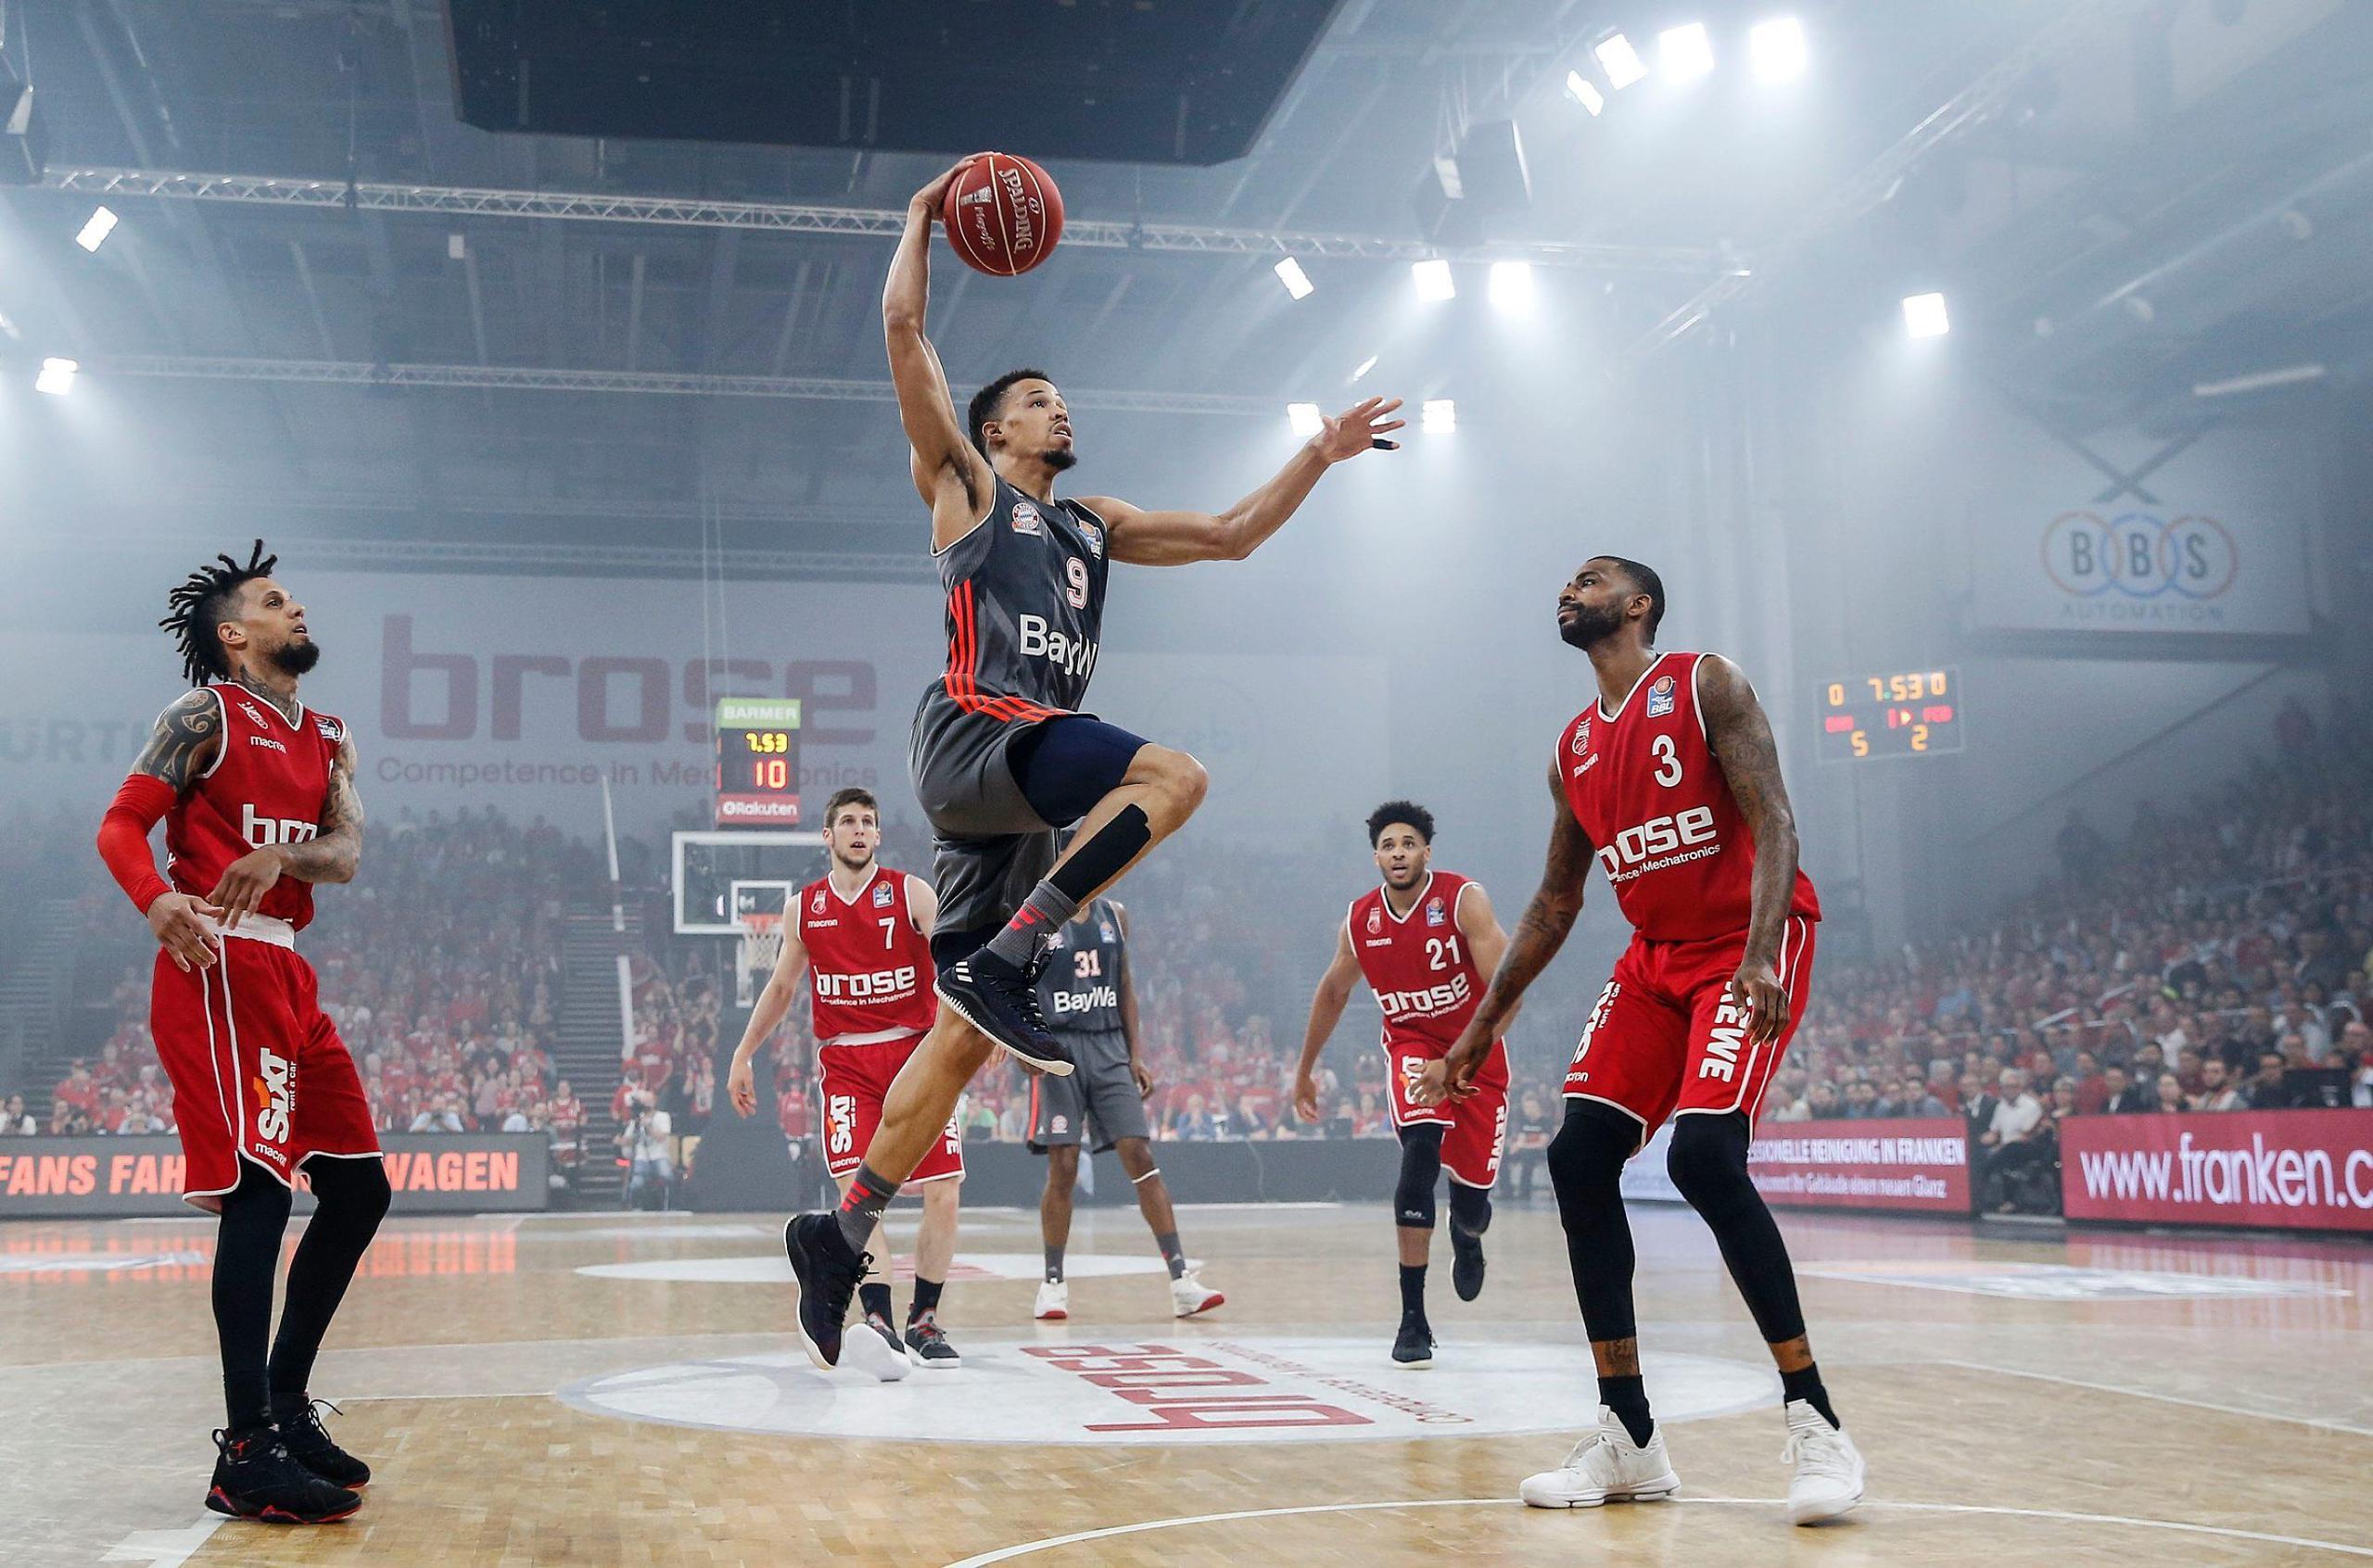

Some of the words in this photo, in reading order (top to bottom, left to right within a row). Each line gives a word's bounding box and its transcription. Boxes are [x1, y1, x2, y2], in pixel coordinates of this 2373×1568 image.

[997, 168, 1033, 254] SPALDING
[2072, 531, 2208, 578] BBS
[1066, 557, 1088, 610] 9
[1020, 614, 1098, 679] BayW
[380, 614, 878, 744] brose
[723, 706, 797, 720] BARMER
[1911, 724, 1928, 752] 2
[377, 756, 603, 789] Competence
[652, 762, 879, 788] Meconics
[755, 759, 787, 789] 10
[1652, 734, 1682, 788] 3
[1643, 844, 1720, 873] Mechatronics
[808, 919, 838, 929] macron
[879, 917, 895, 950] 7
[1073, 949, 1102, 980] 31
[1425, 935, 1461, 971] 21
[813, 965, 916, 996] brose
[1372, 972, 1469, 1016] brose
[1053, 986, 1117, 1013] BayWa
[1698, 980, 1753, 1082] EWE
[1881, 1138, 1897, 1165] IN
[1898, 1138, 1966, 1165] FRANKEN
